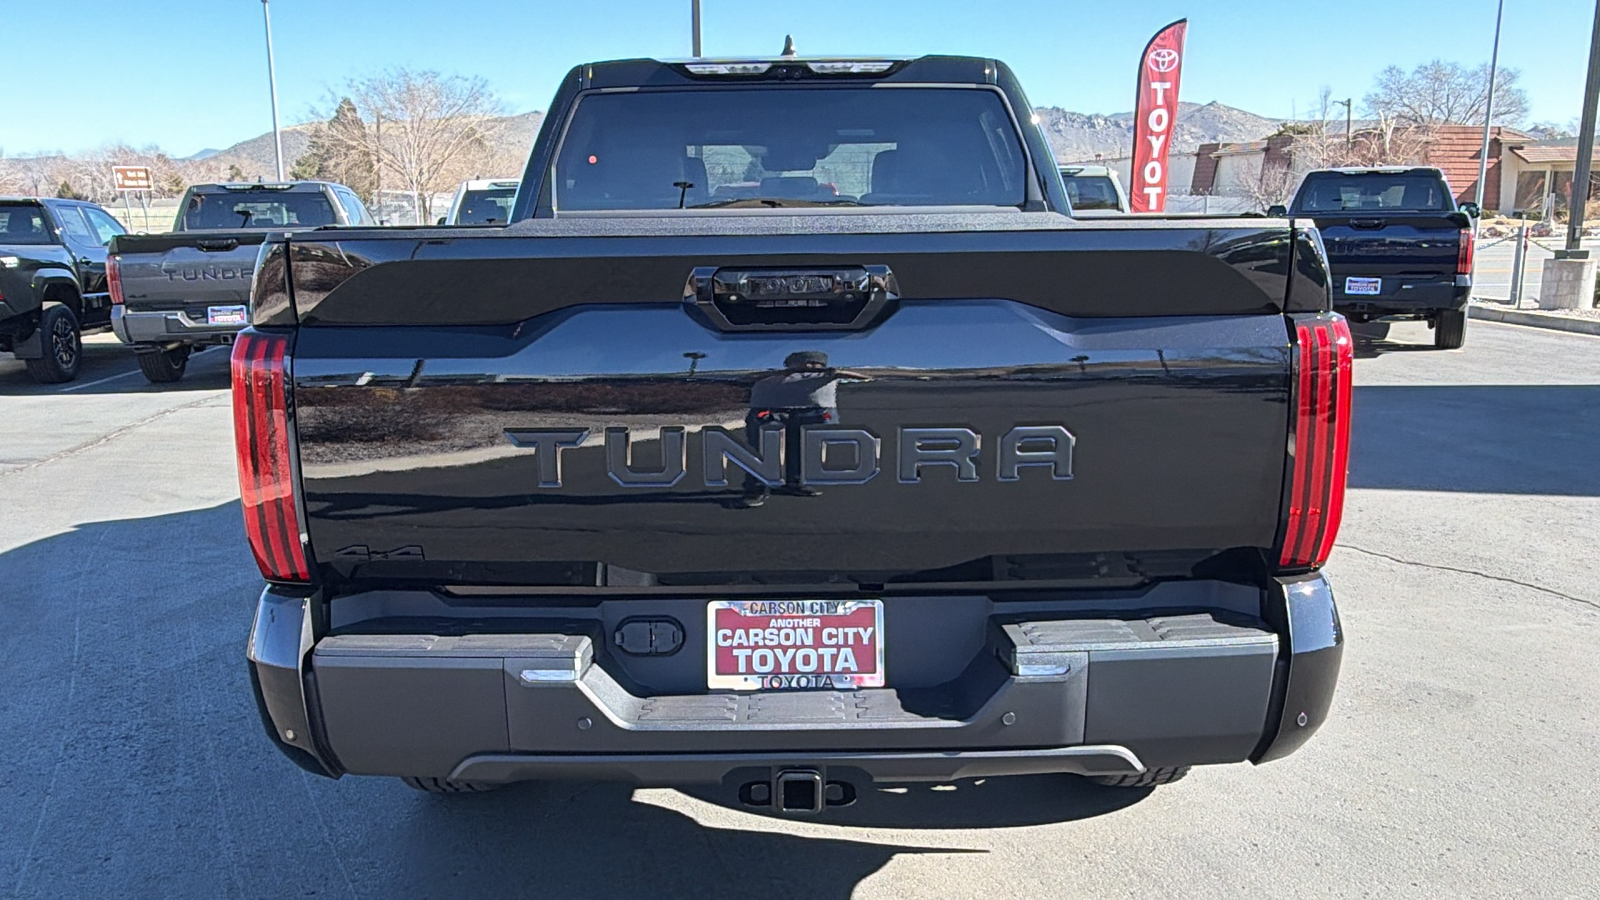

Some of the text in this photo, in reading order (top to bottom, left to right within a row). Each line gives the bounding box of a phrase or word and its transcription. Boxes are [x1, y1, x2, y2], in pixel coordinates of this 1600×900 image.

[503, 425, 1077, 489] TUNDRA
[750, 602, 840, 615] CARSON CITY
[769, 618, 821, 628] ANOTHER
[717, 627, 874, 647] CARSON CITY
[732, 648, 858, 673] TOYOTA
[757, 675, 834, 688] TOYOTA
